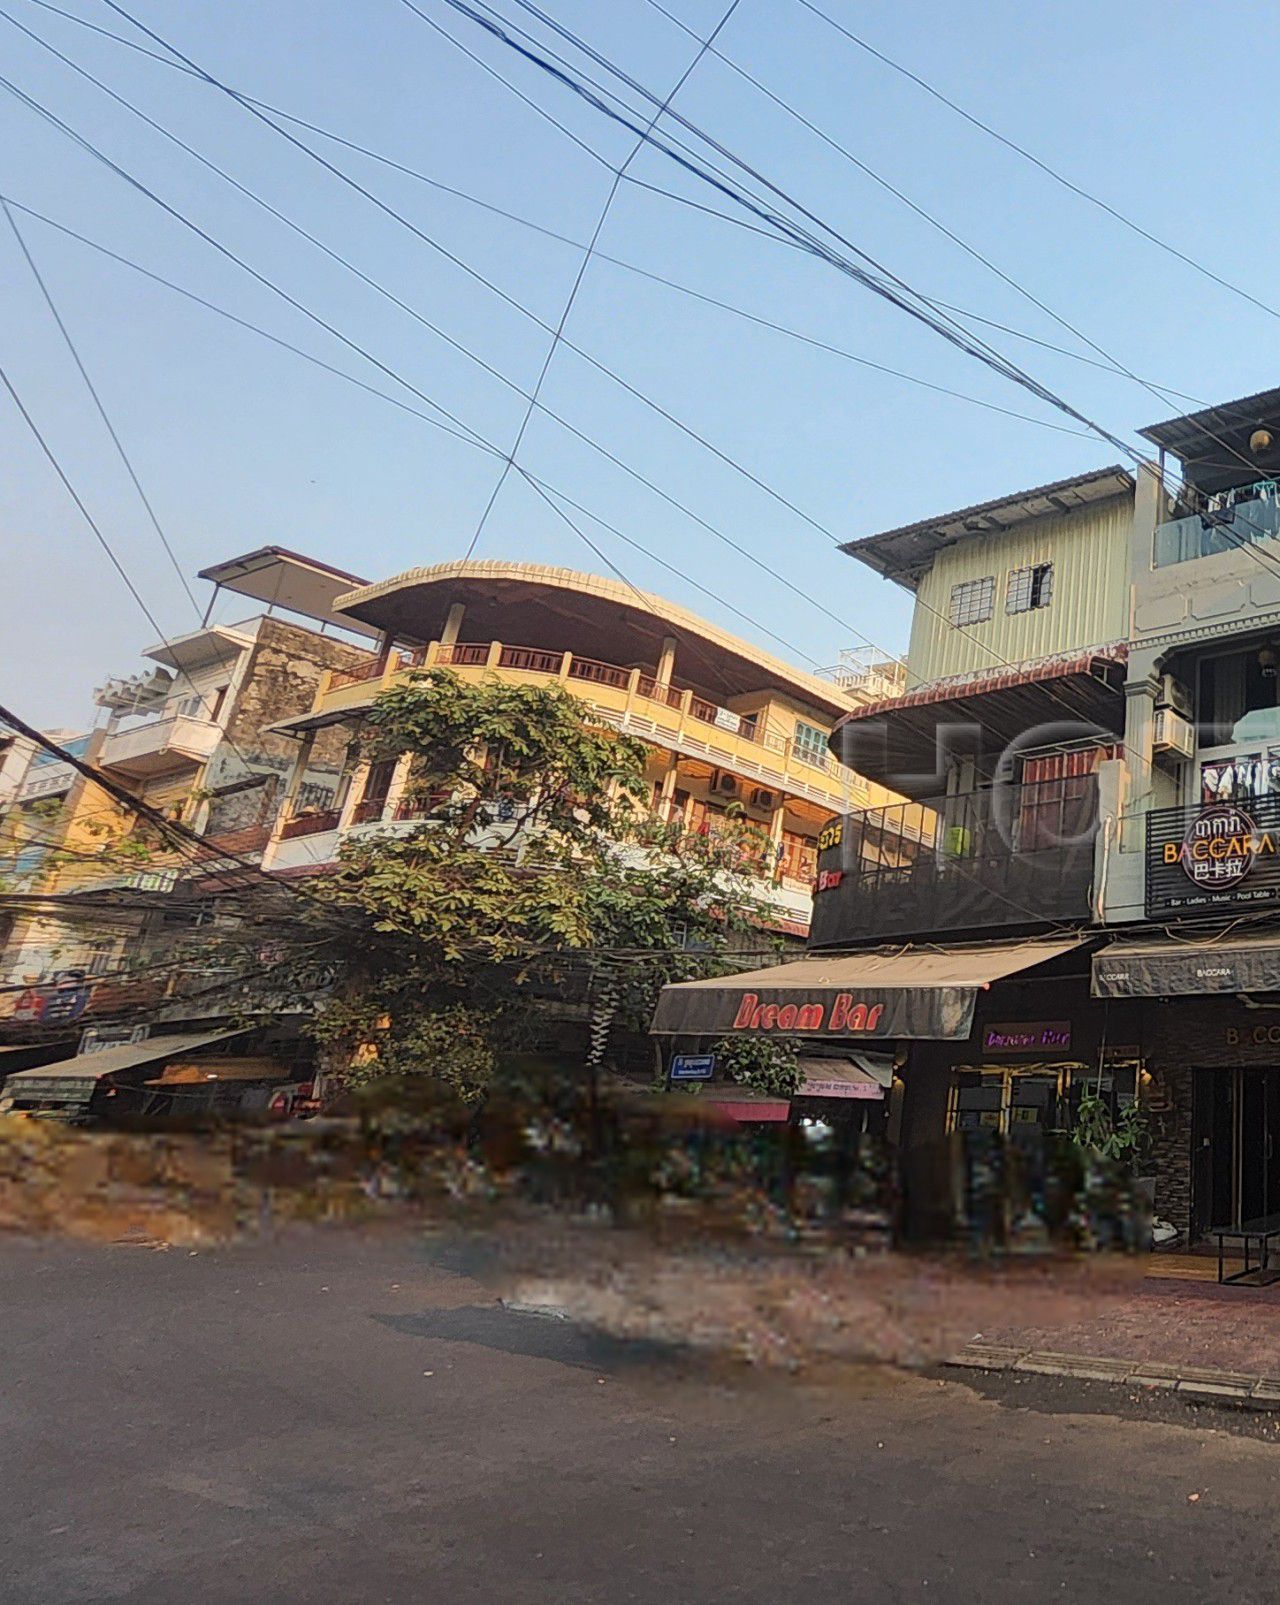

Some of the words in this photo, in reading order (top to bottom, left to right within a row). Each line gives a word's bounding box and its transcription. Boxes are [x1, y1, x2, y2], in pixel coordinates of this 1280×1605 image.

[1164, 833, 1275, 864] BACCARA
[1194, 858, 1244, 881] 巴卡拉
[1171, 898, 1182, 907] Bar
[1186, 896, 1207, 906] Ladies
[1212, 894, 1231, 902] Music
[1237, 892, 1251, 901] Pool
[1253, 890, 1271, 899] Table
[732, 993, 824, 1030] Dream
[828, 993, 884, 1031] Bar
